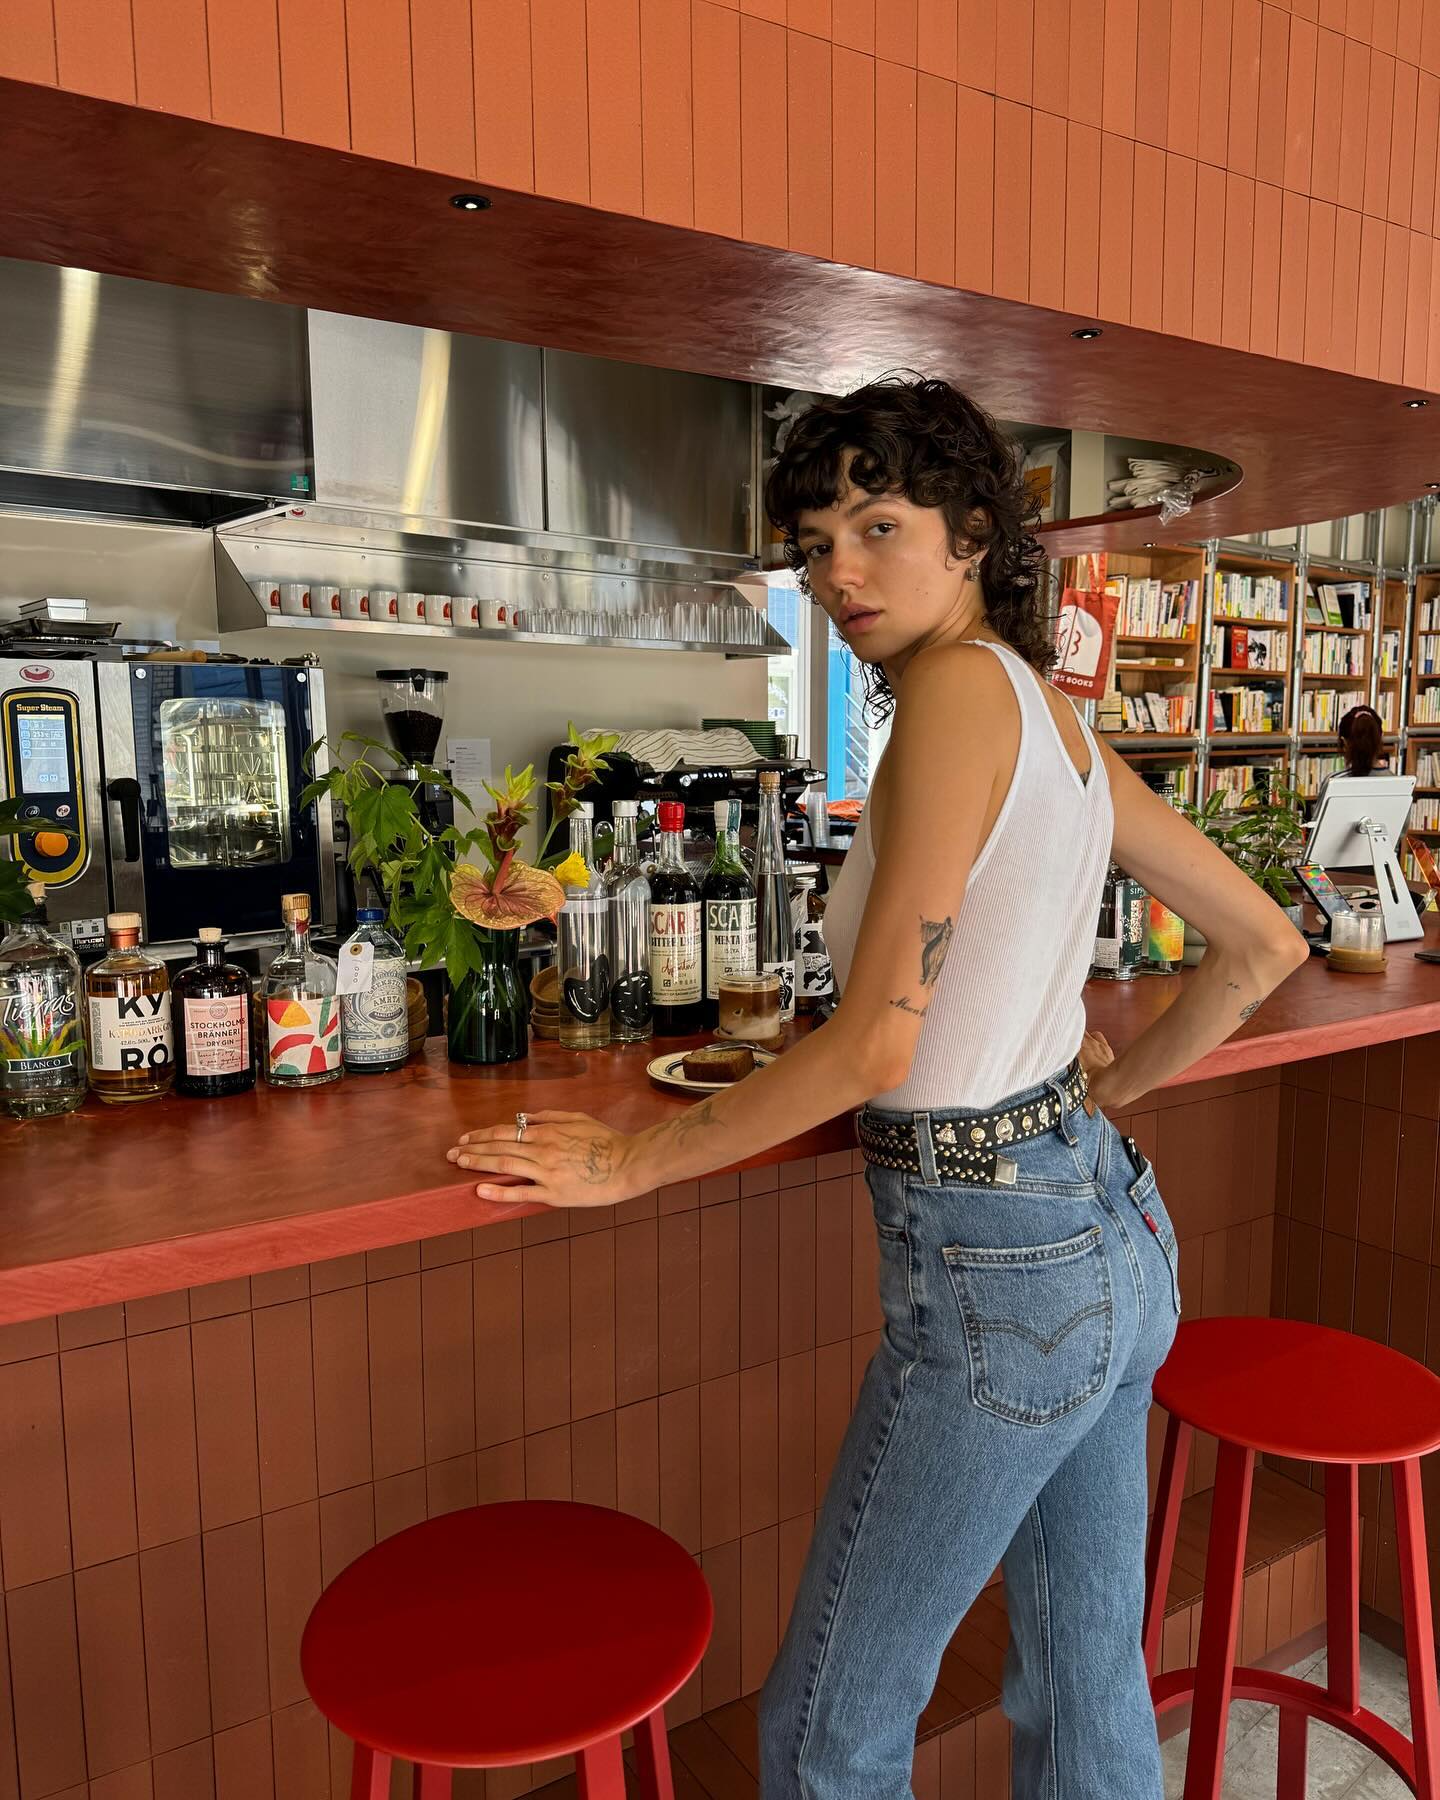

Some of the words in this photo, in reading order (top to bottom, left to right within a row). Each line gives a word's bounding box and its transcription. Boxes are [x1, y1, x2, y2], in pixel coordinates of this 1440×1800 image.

[1066, 675, 1095, 688] BOOKS
[16, 703, 40, 712] Super
[40, 703, 64, 711] Steam
[0, 990, 76, 1027] Tierras
[190, 1017, 246, 1029] STOCKHOLMS
[197, 1028, 240, 1039] BRÄNNERI
[20, 1059, 61, 1071] BLANCO
